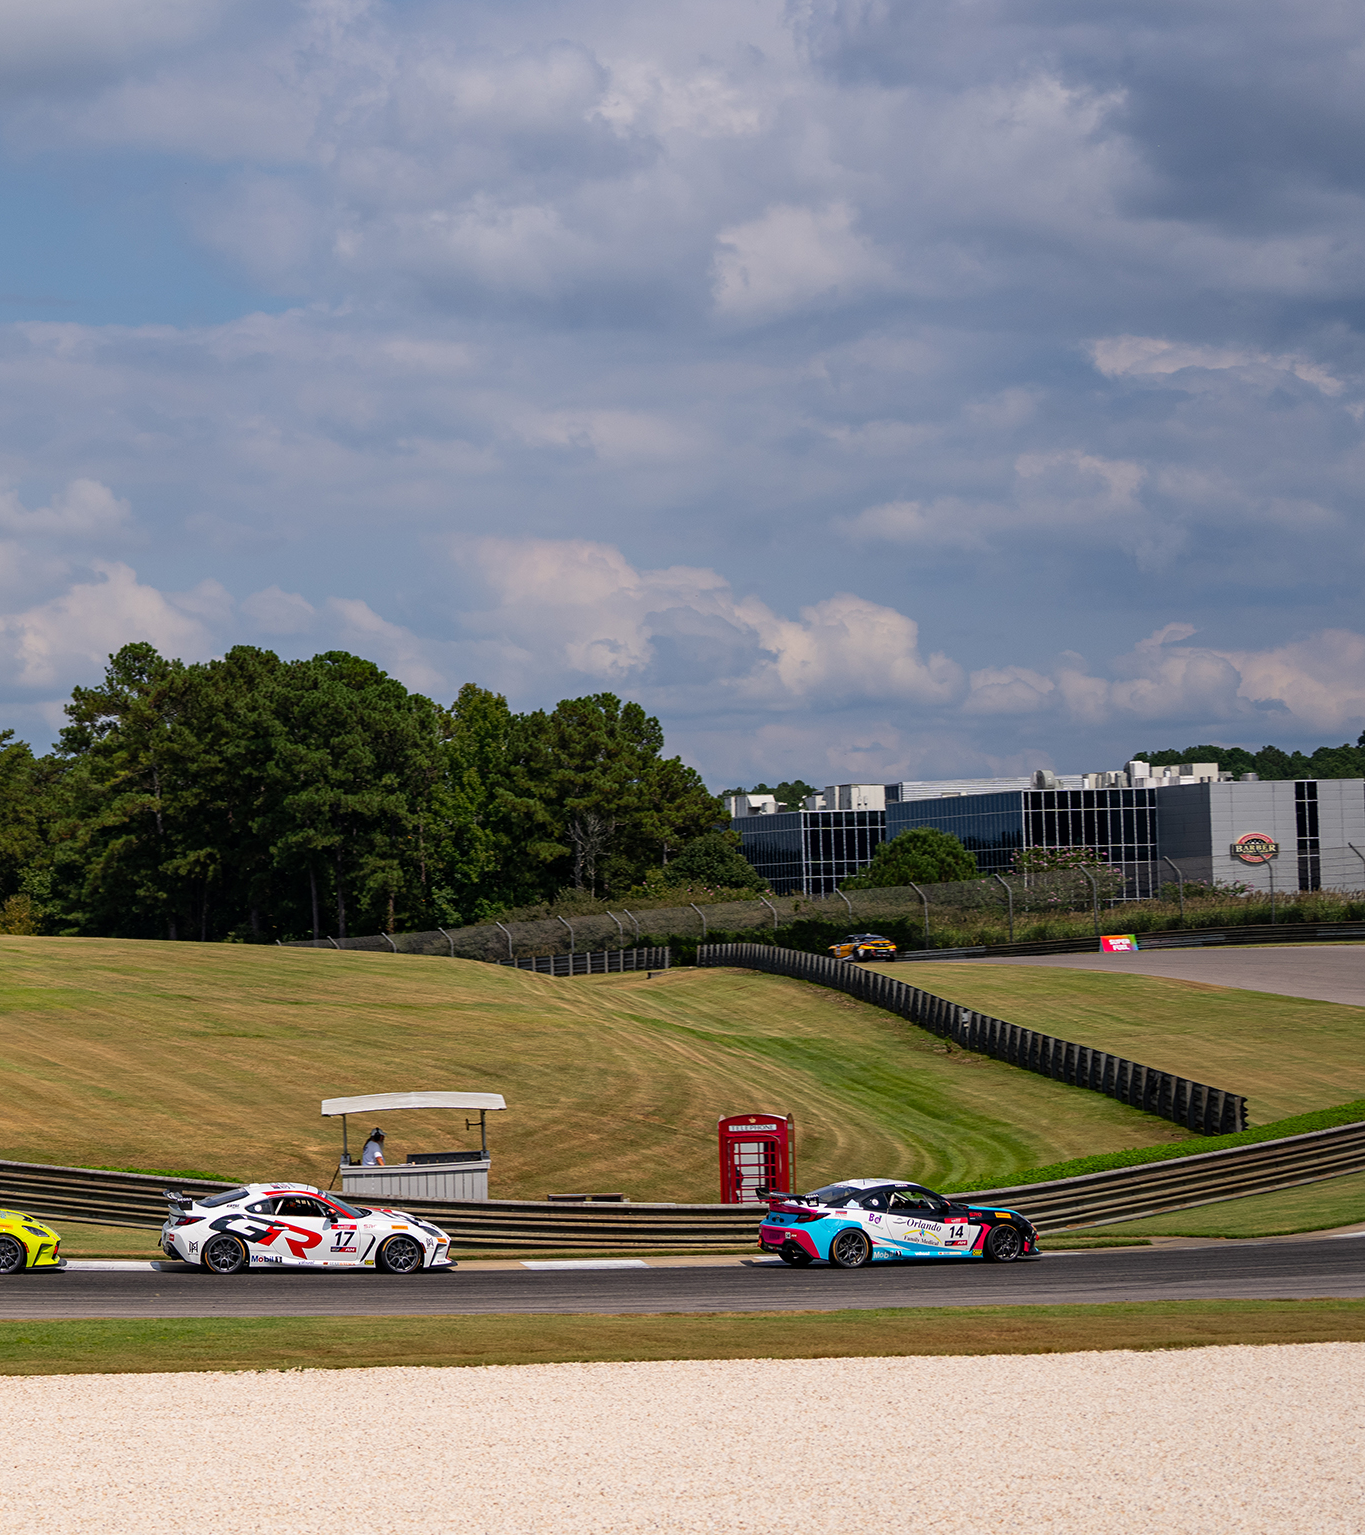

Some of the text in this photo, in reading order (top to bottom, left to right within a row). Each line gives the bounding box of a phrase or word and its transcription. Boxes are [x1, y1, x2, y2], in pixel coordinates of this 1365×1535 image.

[1236, 844, 1276, 853] BARBER
[906, 1218, 942, 1232] Orlando
[949, 1225, 964, 1239] 14
[208, 1213, 323, 1260] GR
[334, 1231, 355, 1247] 17
[903, 1235, 940, 1246] Family Medical
[251, 1255, 274, 1263] Mobil
